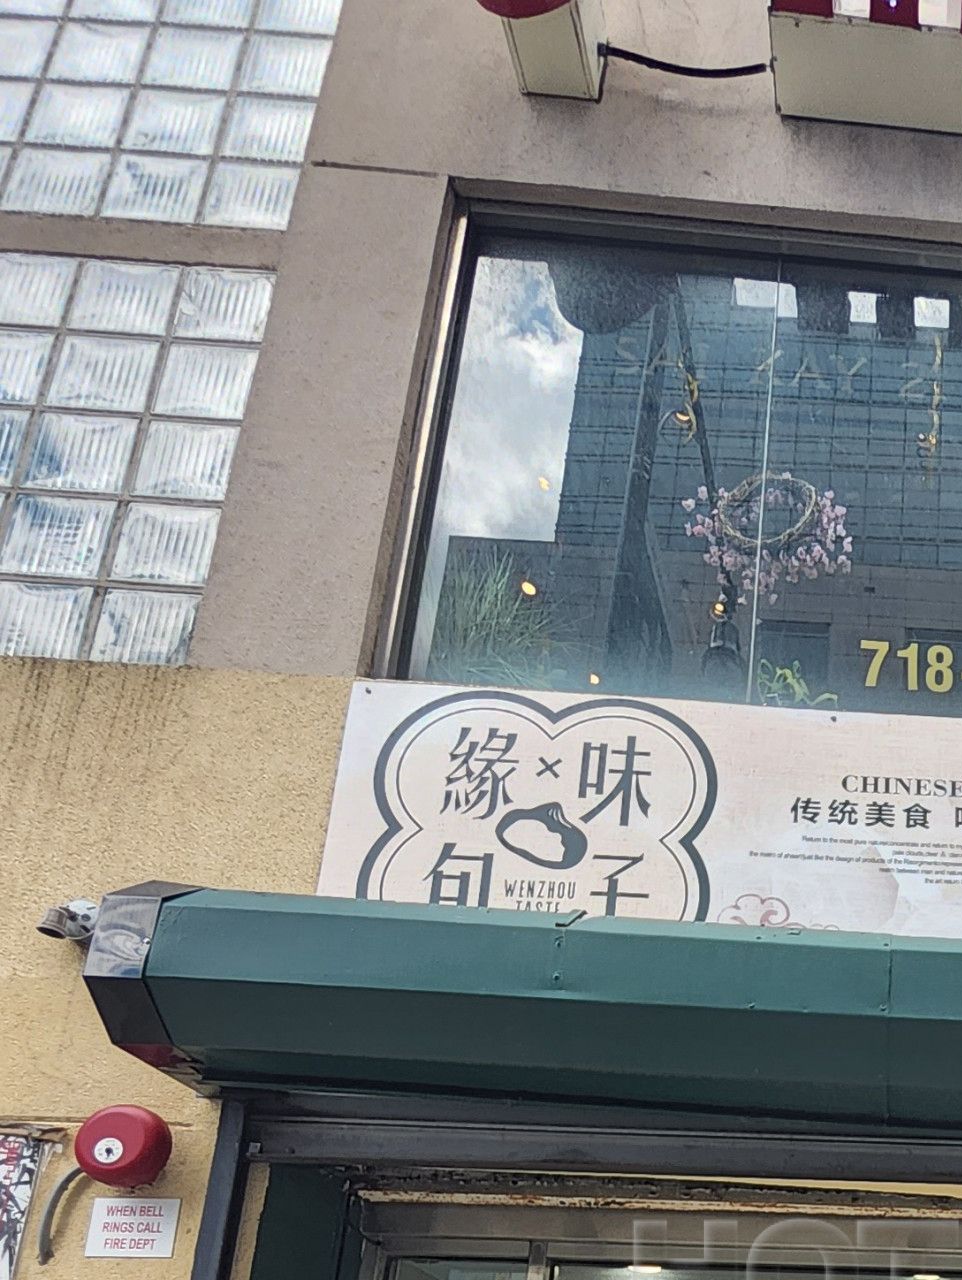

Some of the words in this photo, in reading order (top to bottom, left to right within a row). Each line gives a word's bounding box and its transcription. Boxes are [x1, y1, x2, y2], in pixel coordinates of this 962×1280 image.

[790, 796, 932, 829] 传统美食
[504, 878, 577, 900] WENZHOU
[106, 1205, 137, 1217] WHEN
[139, 1205, 164, 1218] BELL
[102, 1222, 135, 1234] RINGS
[136, 1222, 163, 1234] CALL
[103, 1238, 128, 1250] FIRE
[128, 1238, 156, 1251] DEPT
